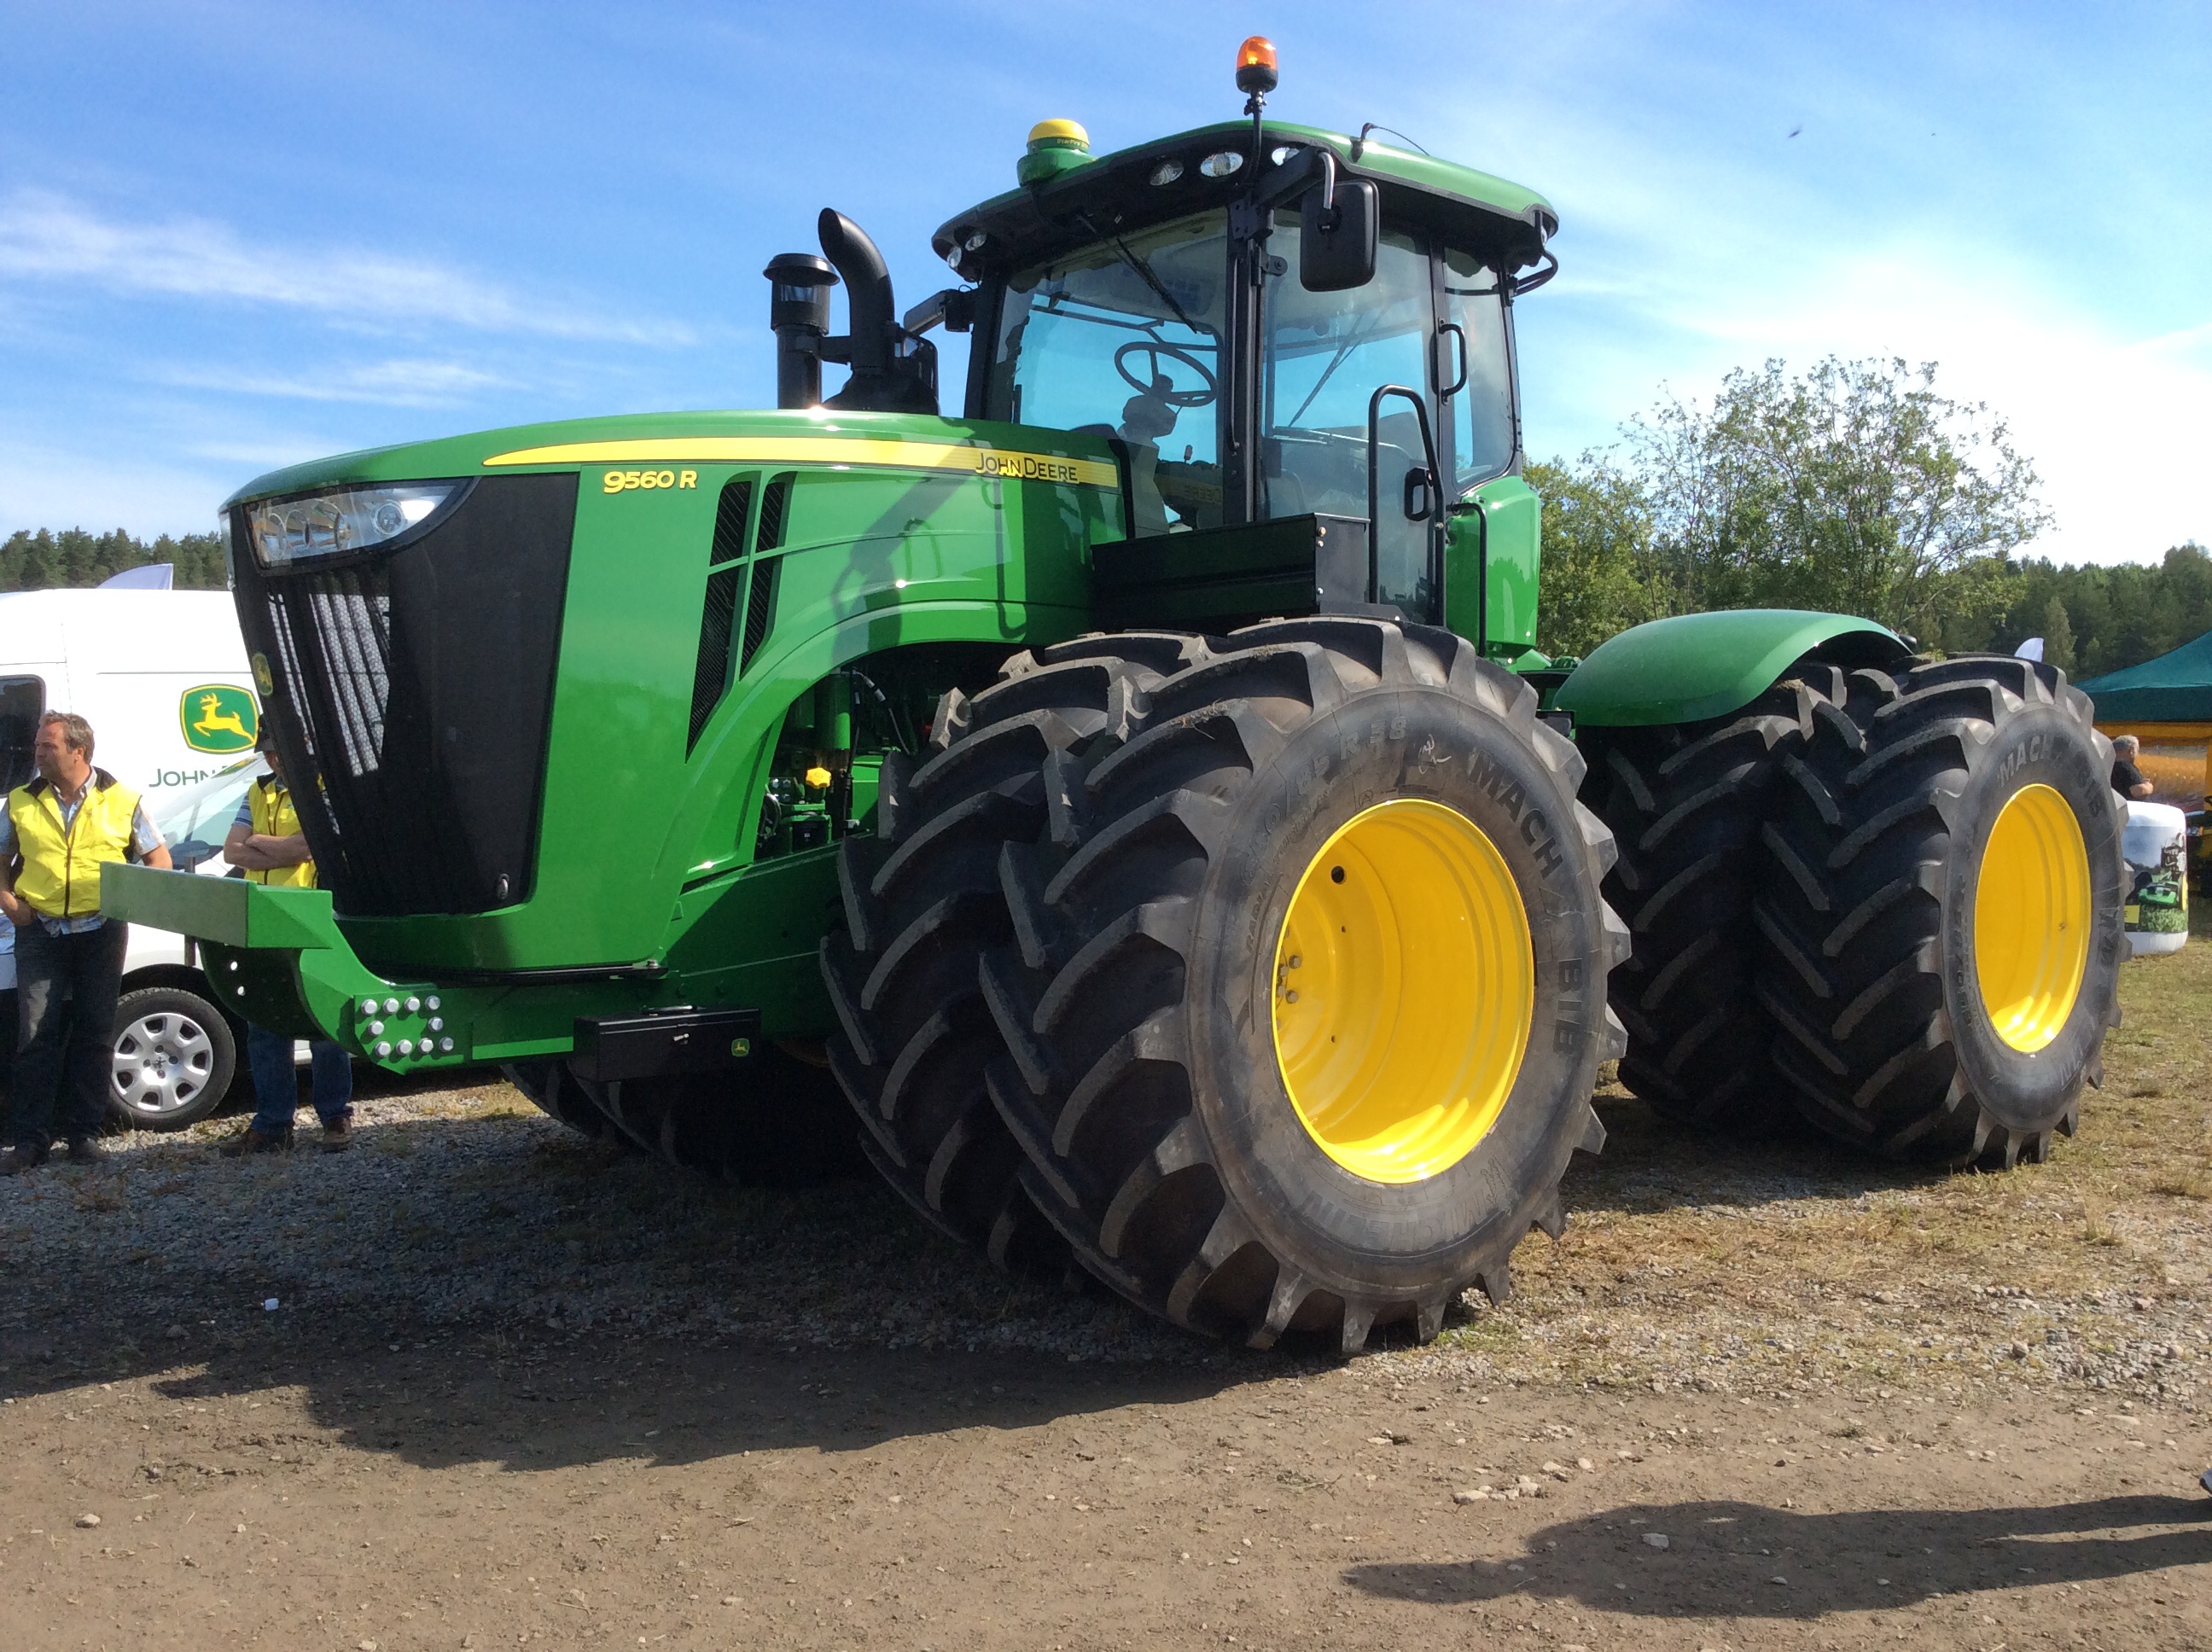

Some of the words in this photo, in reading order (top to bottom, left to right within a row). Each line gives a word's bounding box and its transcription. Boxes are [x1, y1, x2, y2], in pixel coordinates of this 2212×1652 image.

[603, 469, 676, 494] 9560
[679, 469, 698, 489] R
[975, 452, 1022, 474] JOHN
[1023, 457, 1079, 482] DEERE
[1467, 749, 1563, 881] MACH
[1552, 957, 1583, 1056] BIB
